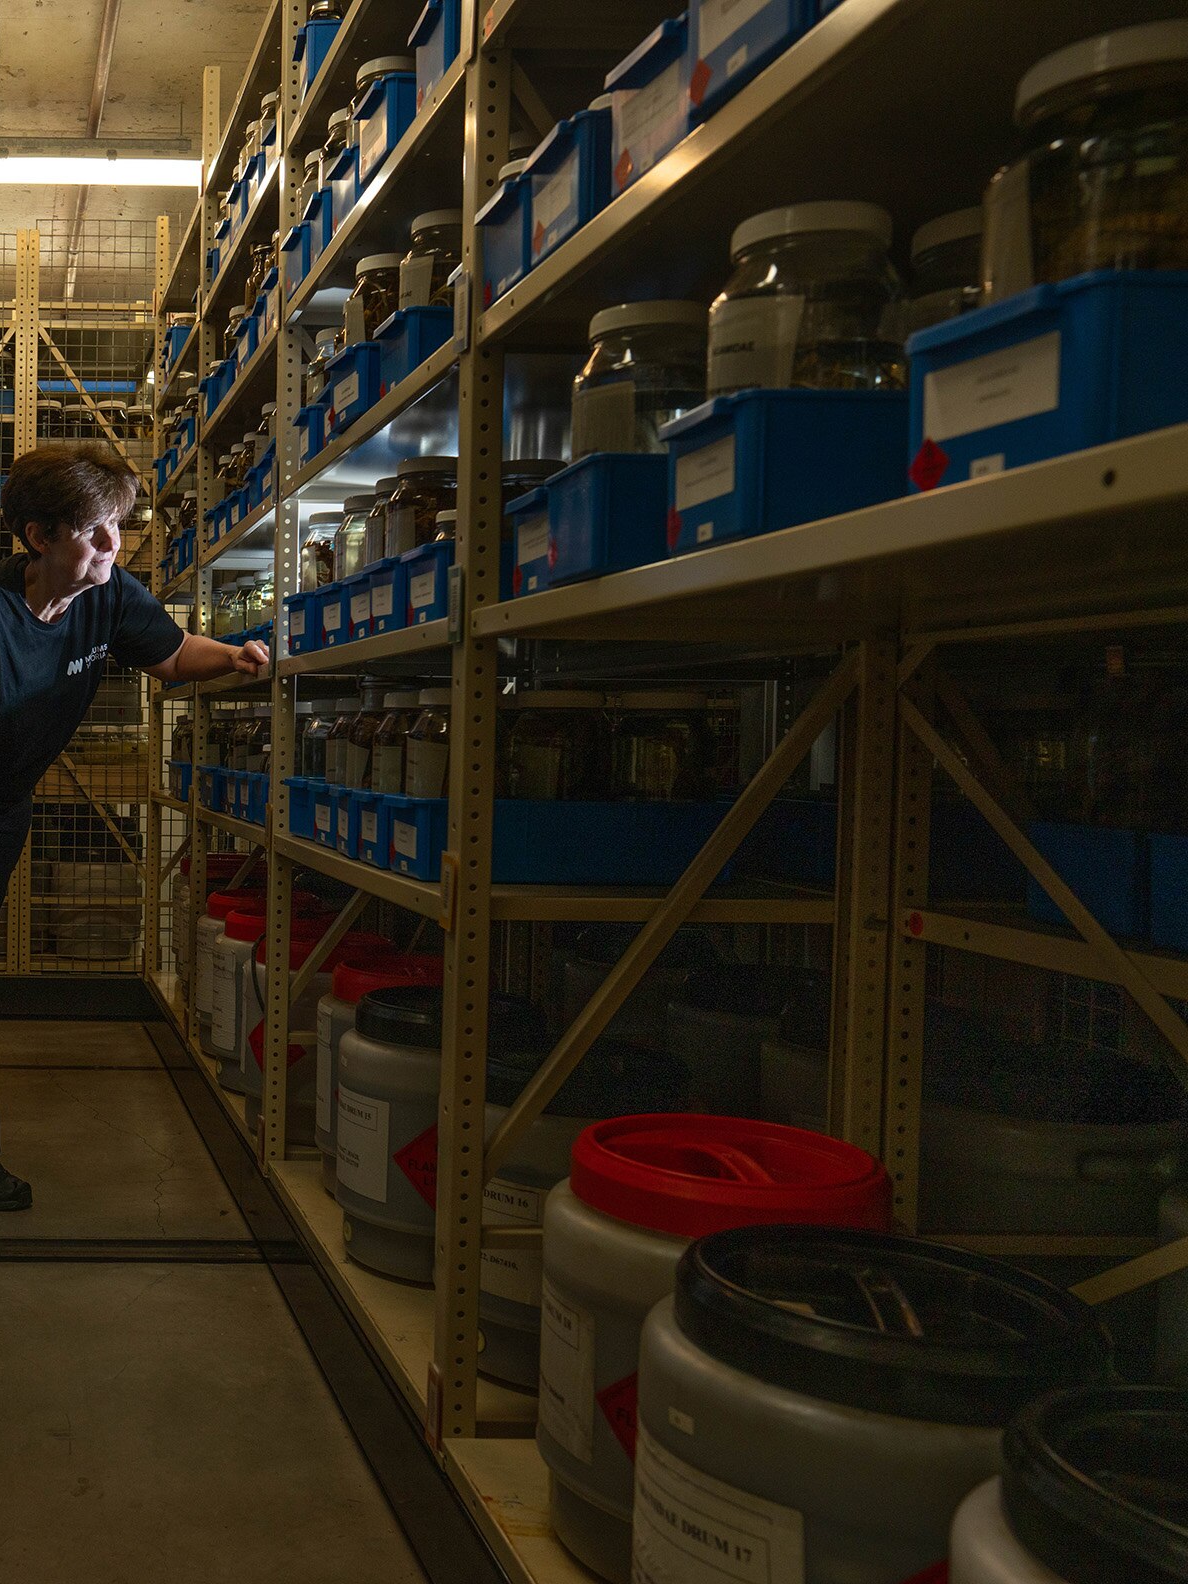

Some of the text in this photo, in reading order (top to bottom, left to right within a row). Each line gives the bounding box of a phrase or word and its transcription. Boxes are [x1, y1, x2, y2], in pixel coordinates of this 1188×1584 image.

[483, 1188, 529, 1208] DRUM 16
[681, 1519, 730, 1555] DRUM
[734, 1545, 753, 1563] 17
